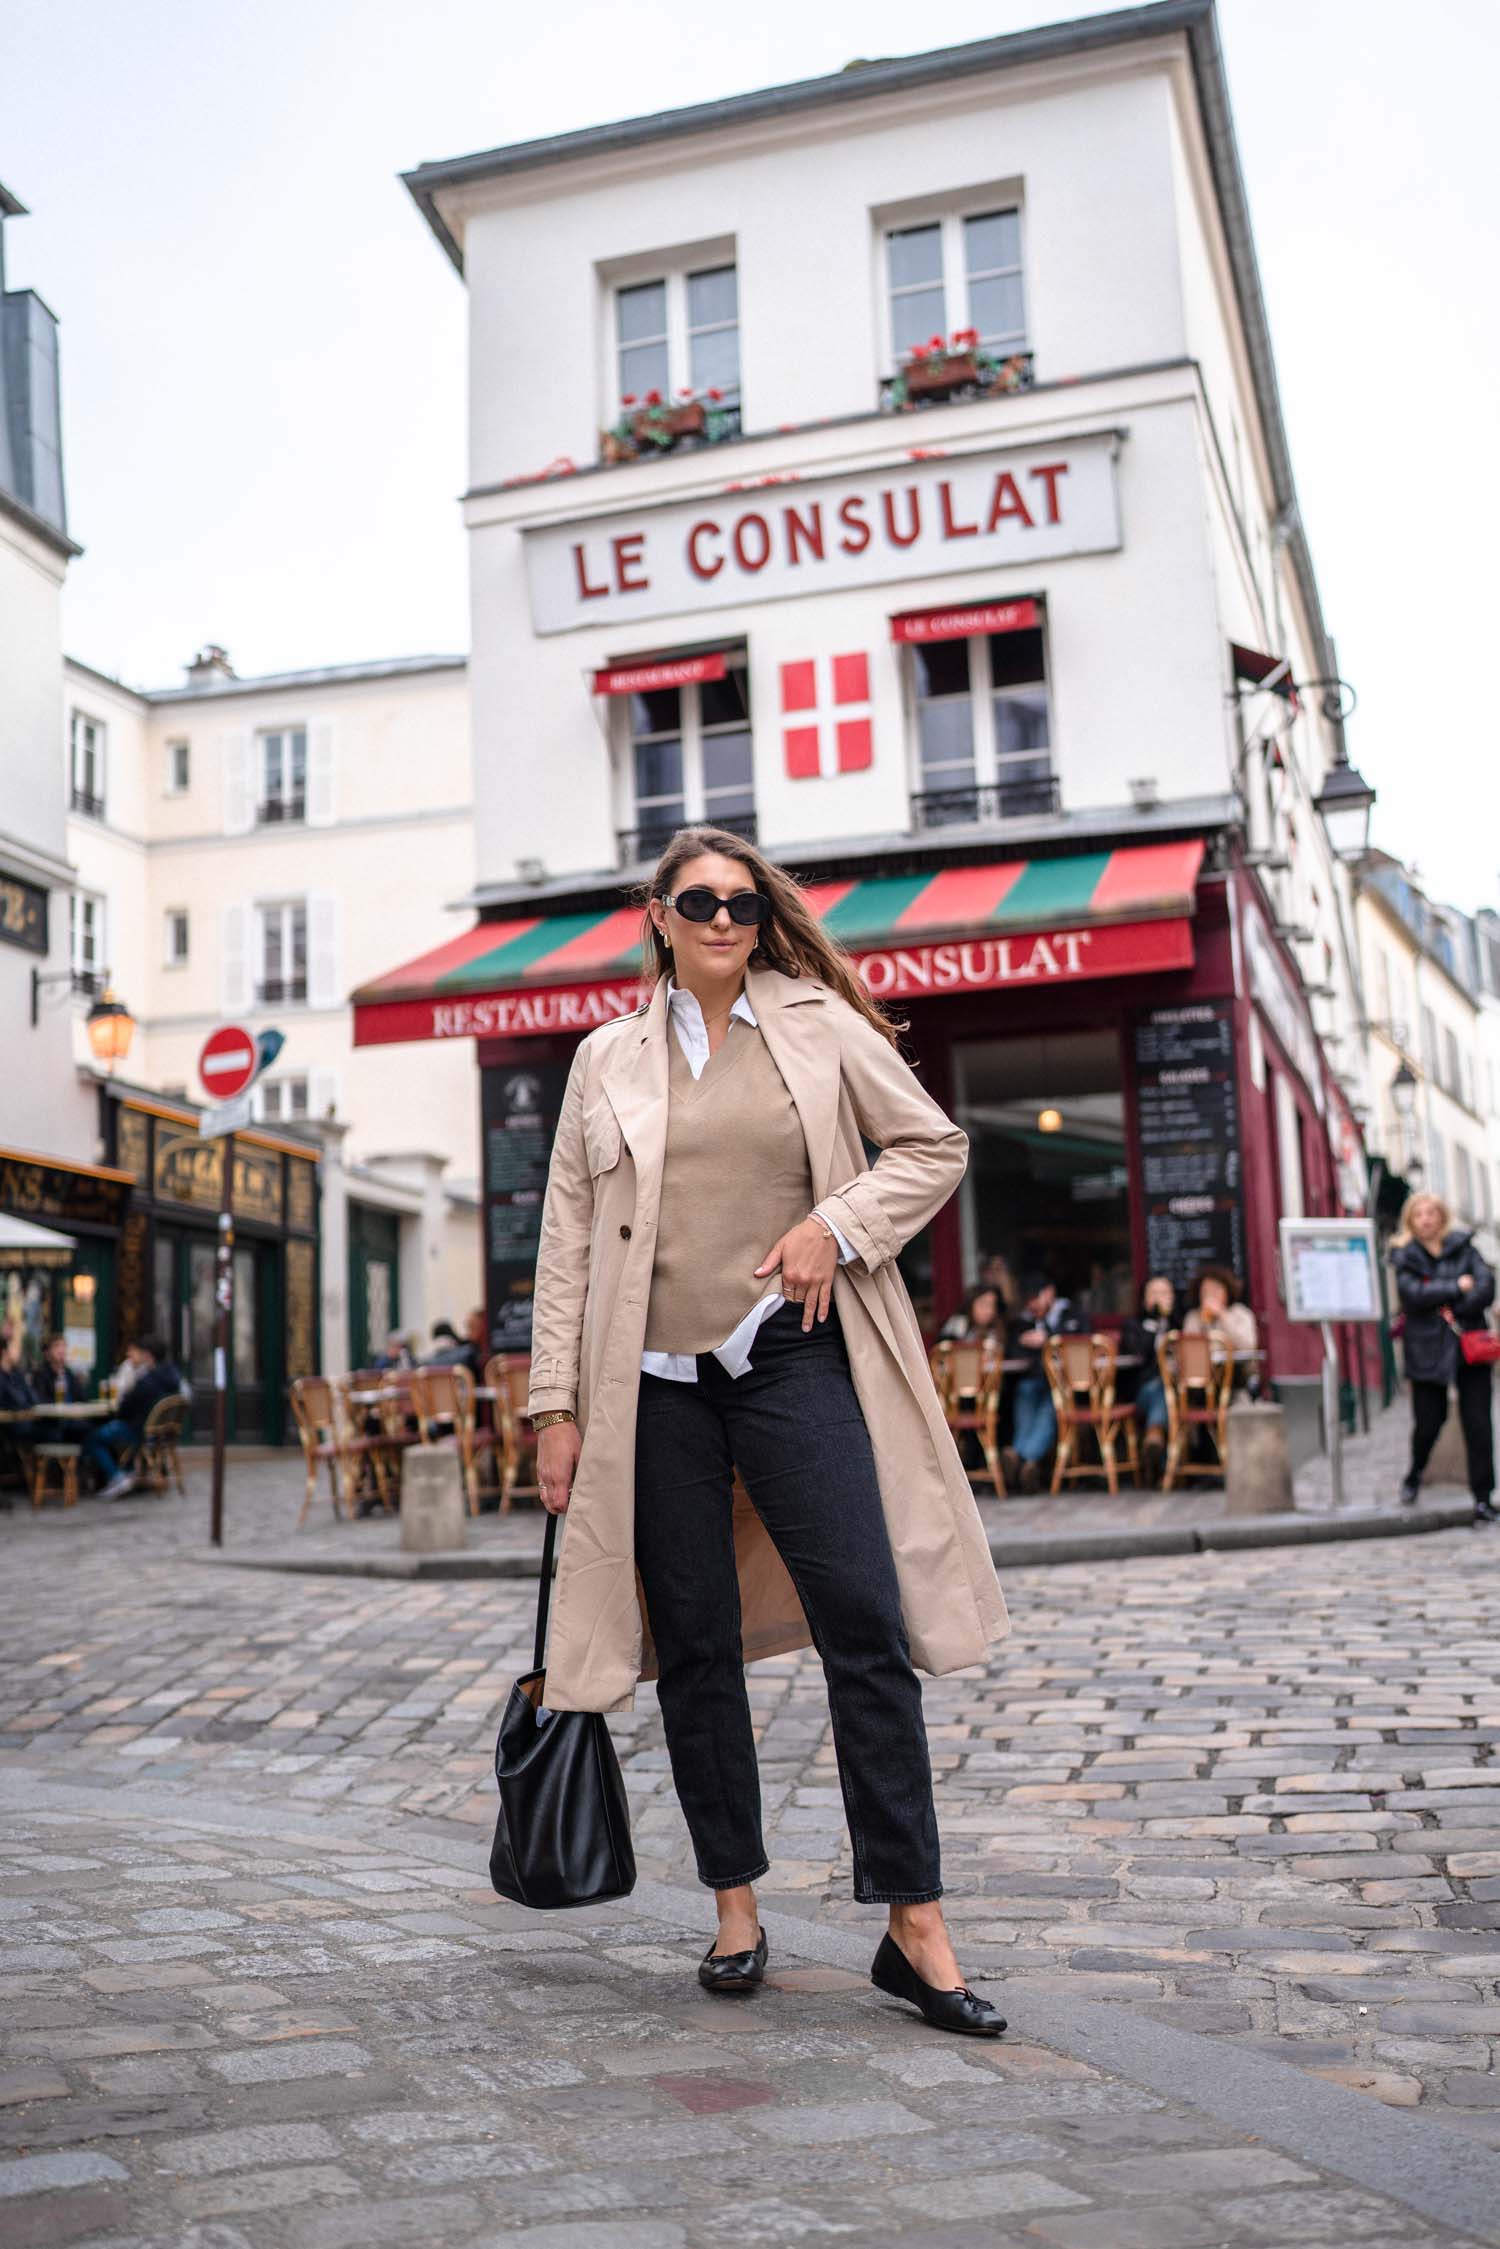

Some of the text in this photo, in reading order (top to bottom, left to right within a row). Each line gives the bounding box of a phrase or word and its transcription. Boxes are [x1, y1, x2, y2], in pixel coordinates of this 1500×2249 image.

[572, 462, 1069, 600] LE CONSULAT
[852, 930, 1092, 994] ONSULAT
